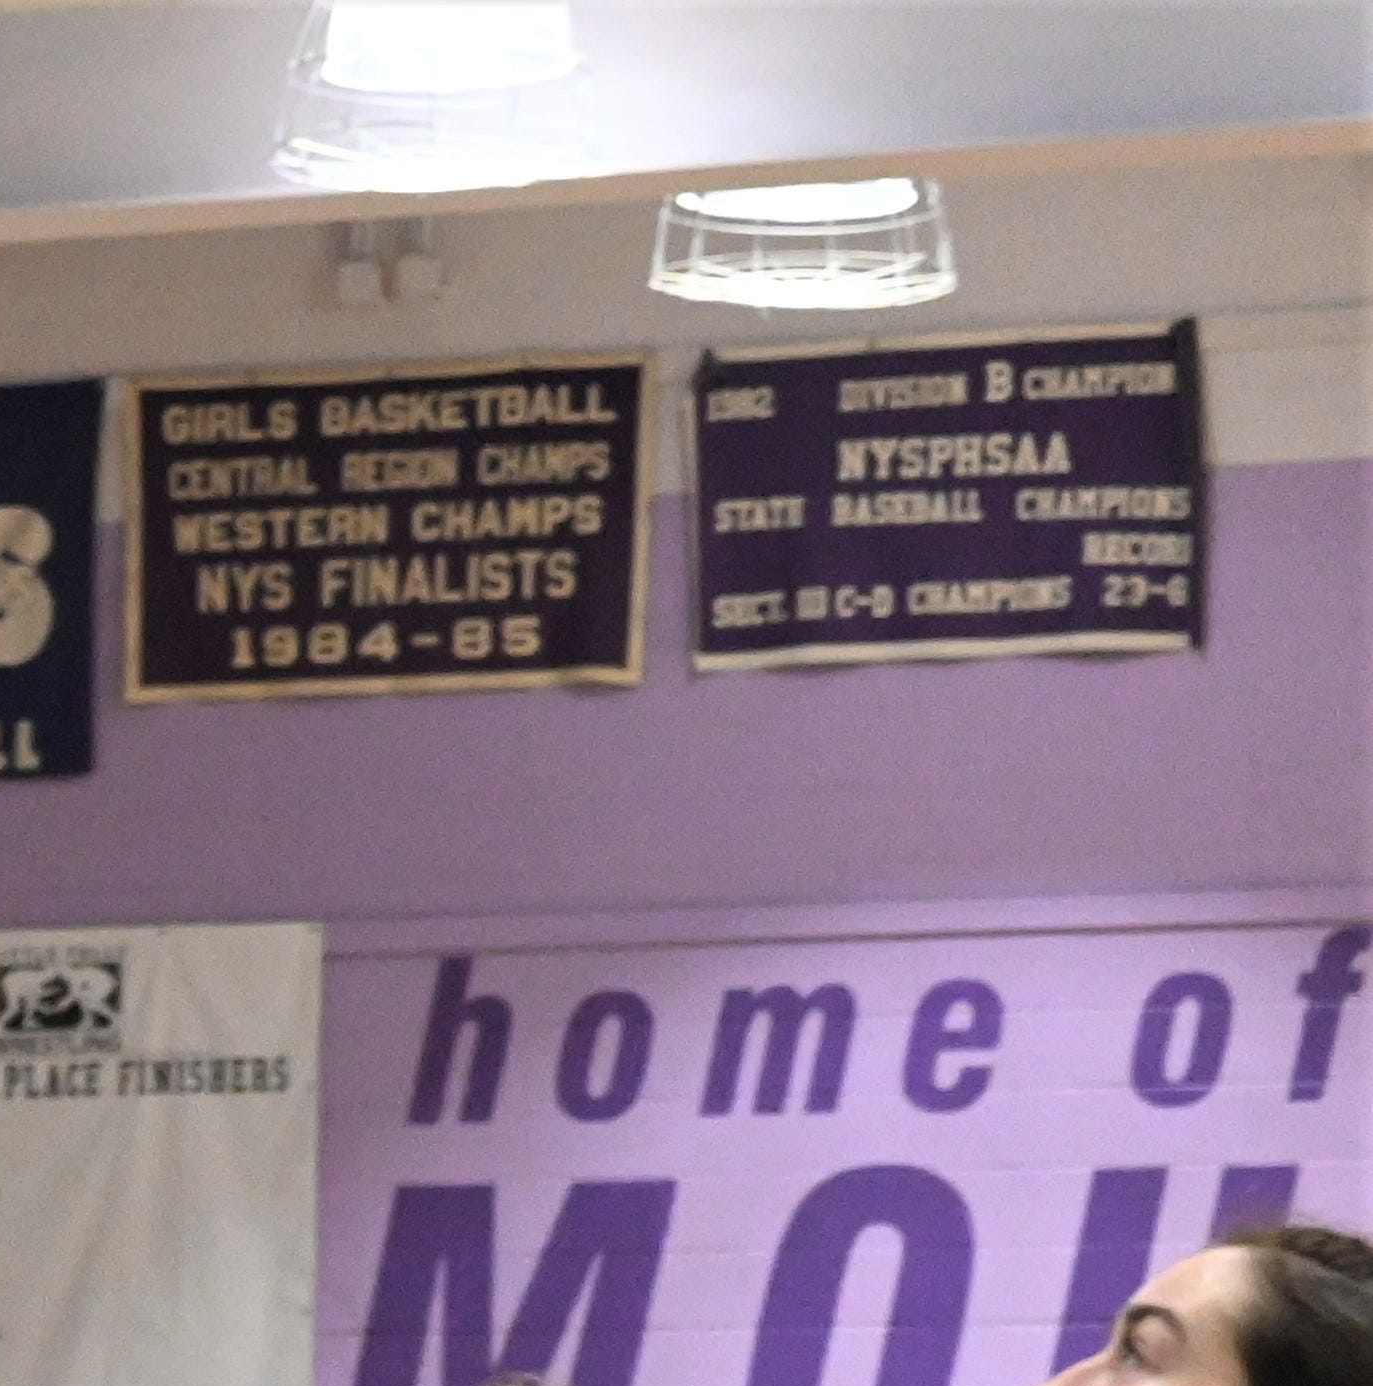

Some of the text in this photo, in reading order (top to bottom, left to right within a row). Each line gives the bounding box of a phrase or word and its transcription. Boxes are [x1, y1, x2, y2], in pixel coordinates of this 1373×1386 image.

[837, 372, 969, 412] DIVISION
[984, 359, 1014, 402] B
[1021, 361, 1177, 401] CHAMPION
[162, 382, 618, 445] GIRLS BASKETBALL
[169, 456, 318, 500] CENTRAL
[477, 441, 610, 487] CHAMPS
[836, 430, 1072, 482] NYSPHSAA
[172, 494, 603, 553] WESTERN CHAMPS
[714, 495, 806, 533] STATE
[1014, 486, 1193, 522] CHAMPIONS
[196, 549, 577, 614] NYS FINALISTS
[906, 576, 1074, 616] CHAMPIONS
[229, 615, 542, 670] 1984-85
[406, 924, 1373, 1126] home of
[3, 1062, 101, 1099] PLACE
[117, 1055, 291, 1096] FINISHERS
